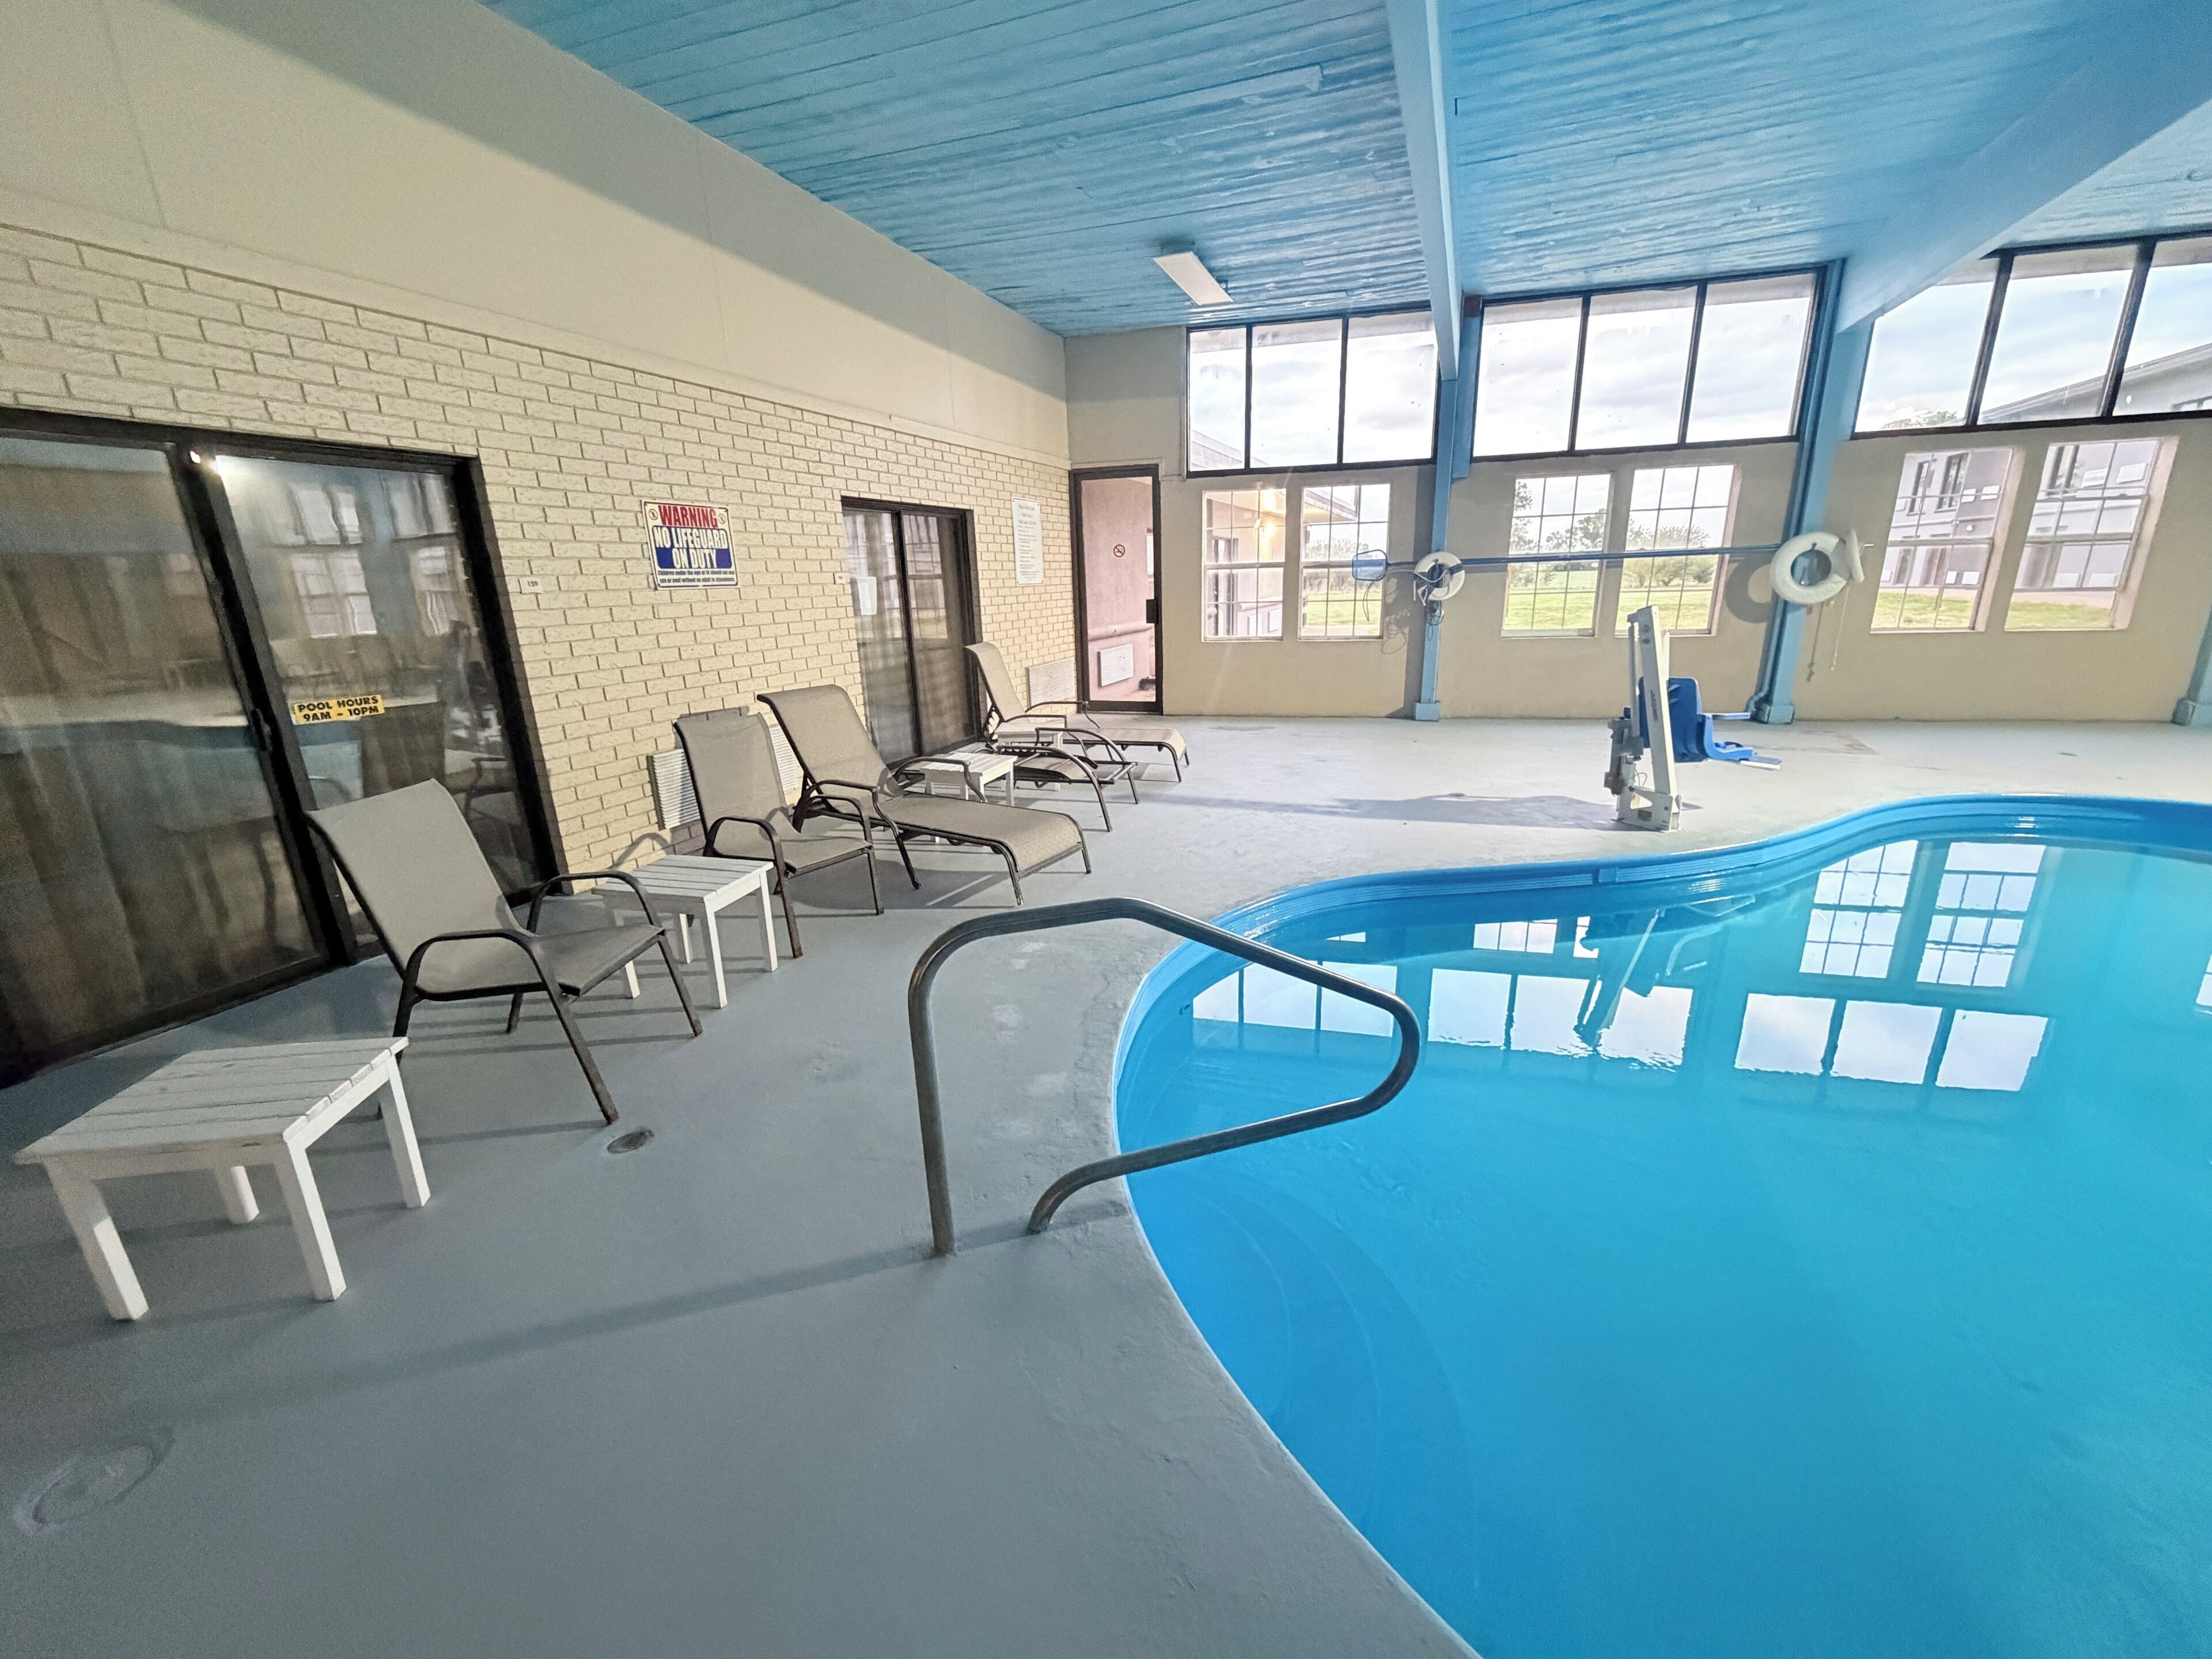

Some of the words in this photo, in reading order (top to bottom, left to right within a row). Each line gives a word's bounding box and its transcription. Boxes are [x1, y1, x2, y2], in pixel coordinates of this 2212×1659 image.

[658, 505, 718, 528] WARNING
[653, 527, 671, 548] NO
[671, 527, 728, 549] LIFEGUARD
[672, 548, 689, 569] ON
[688, 548, 717, 569] DUTY
[298, 702, 332, 713] POOL
[337, 696, 378, 708] HOURS
[304, 712, 332, 722] 9AM
[348, 706, 379, 716] 10PM
